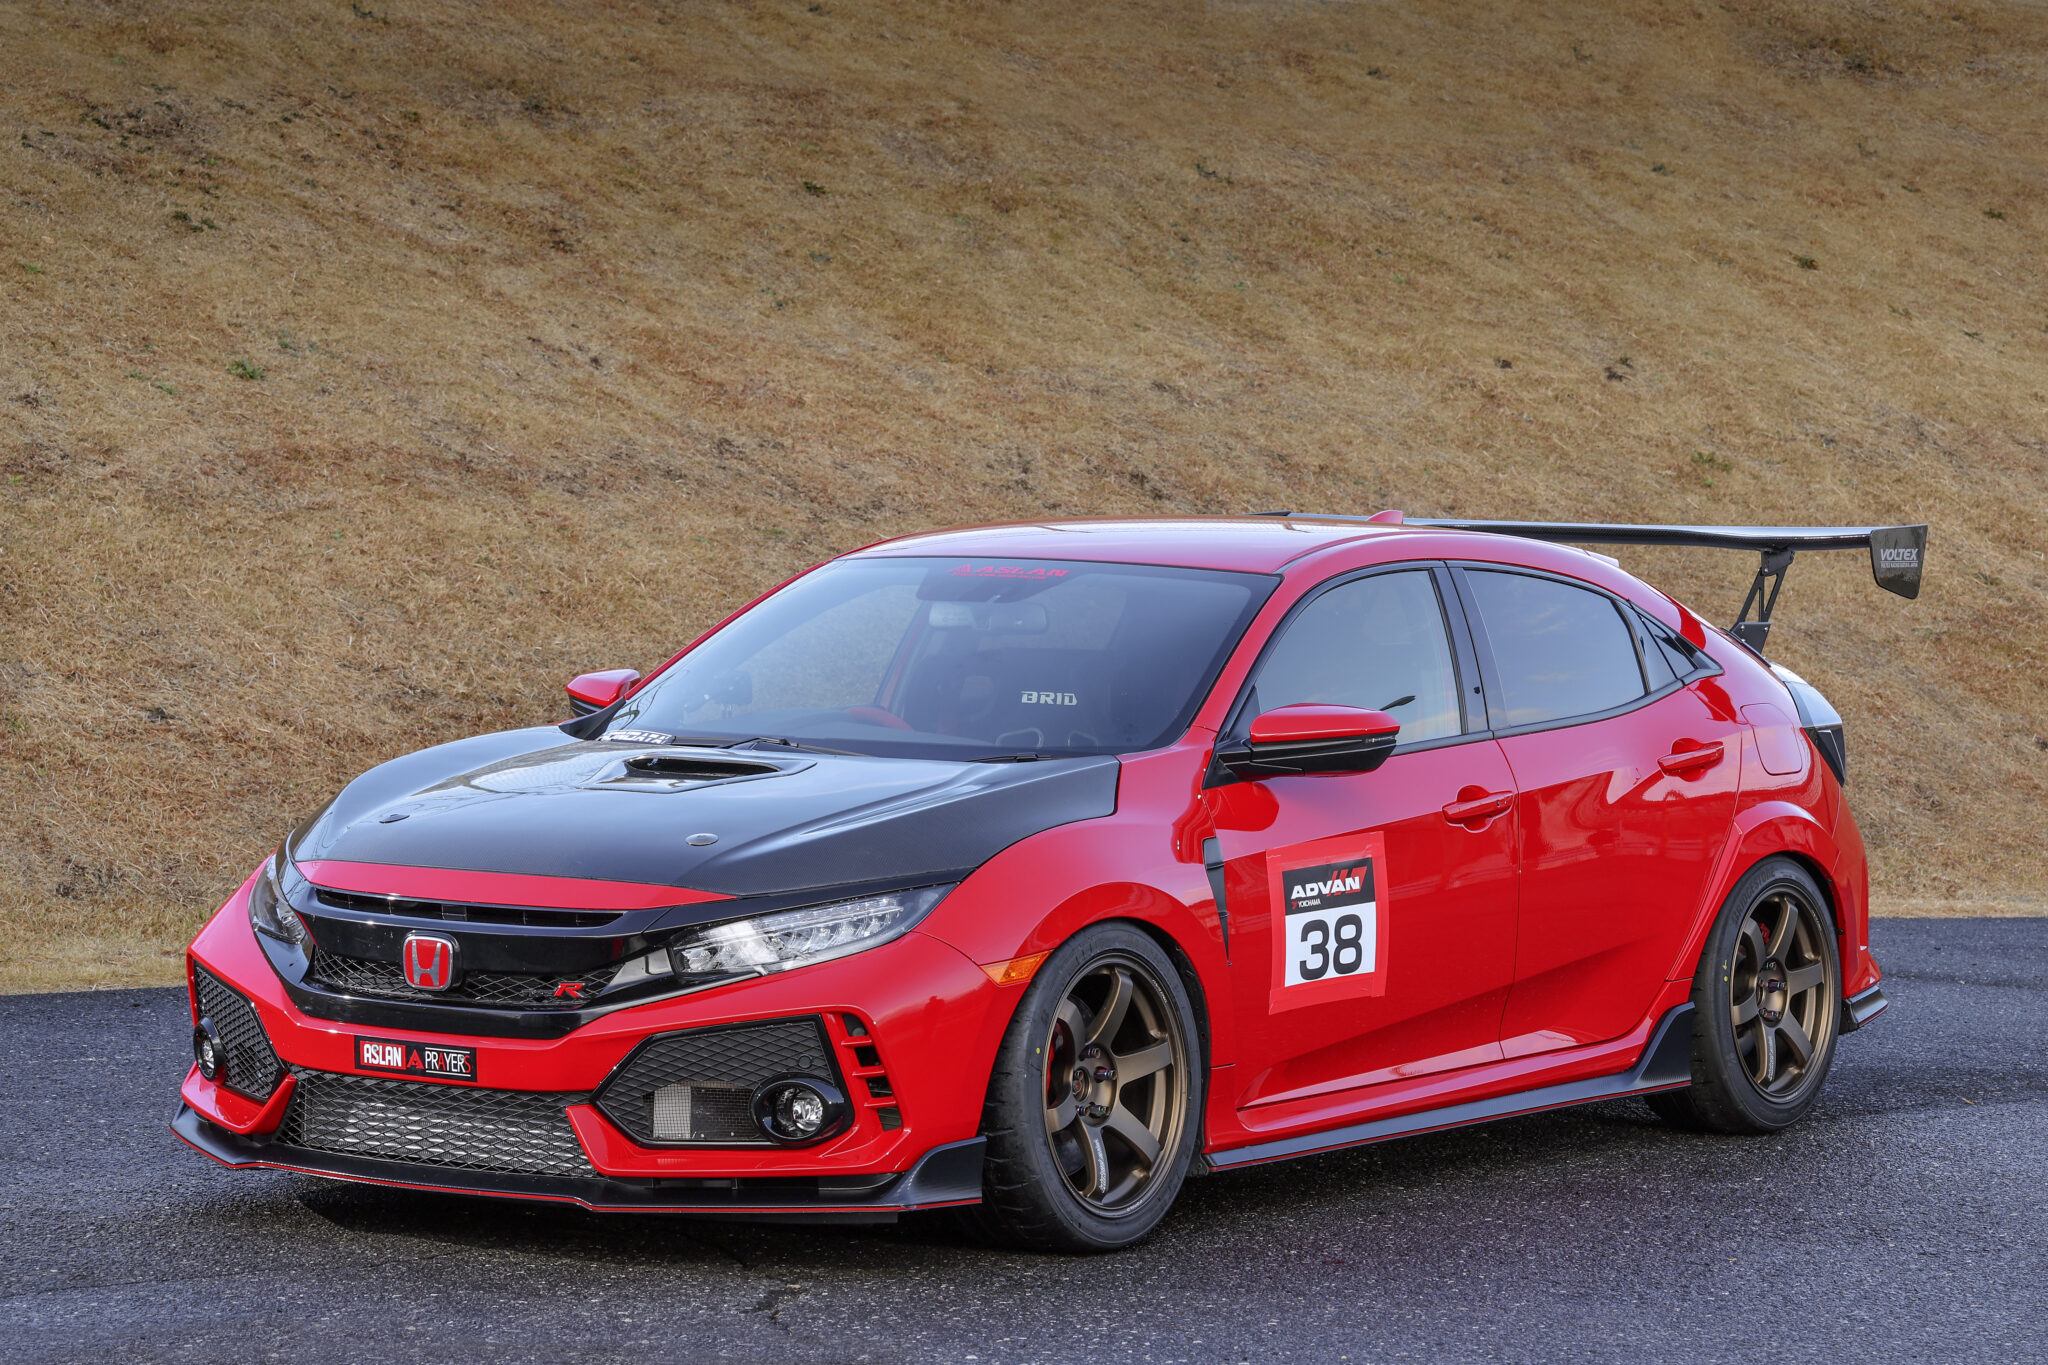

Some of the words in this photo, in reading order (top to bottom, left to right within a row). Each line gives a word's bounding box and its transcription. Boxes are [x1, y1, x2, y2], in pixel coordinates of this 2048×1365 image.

[1880, 548, 1919, 561] VOLTEX
[974, 566, 1070, 577] ASLAN
[1290, 876, 1361, 900] ADVAN
[1297, 898, 1321, 908] YOKOHAMA
[1299, 913, 1363, 981] 38
[363, 1043, 402, 1067] ASLAN
[424, 1050, 472, 1073] PRAYERS
